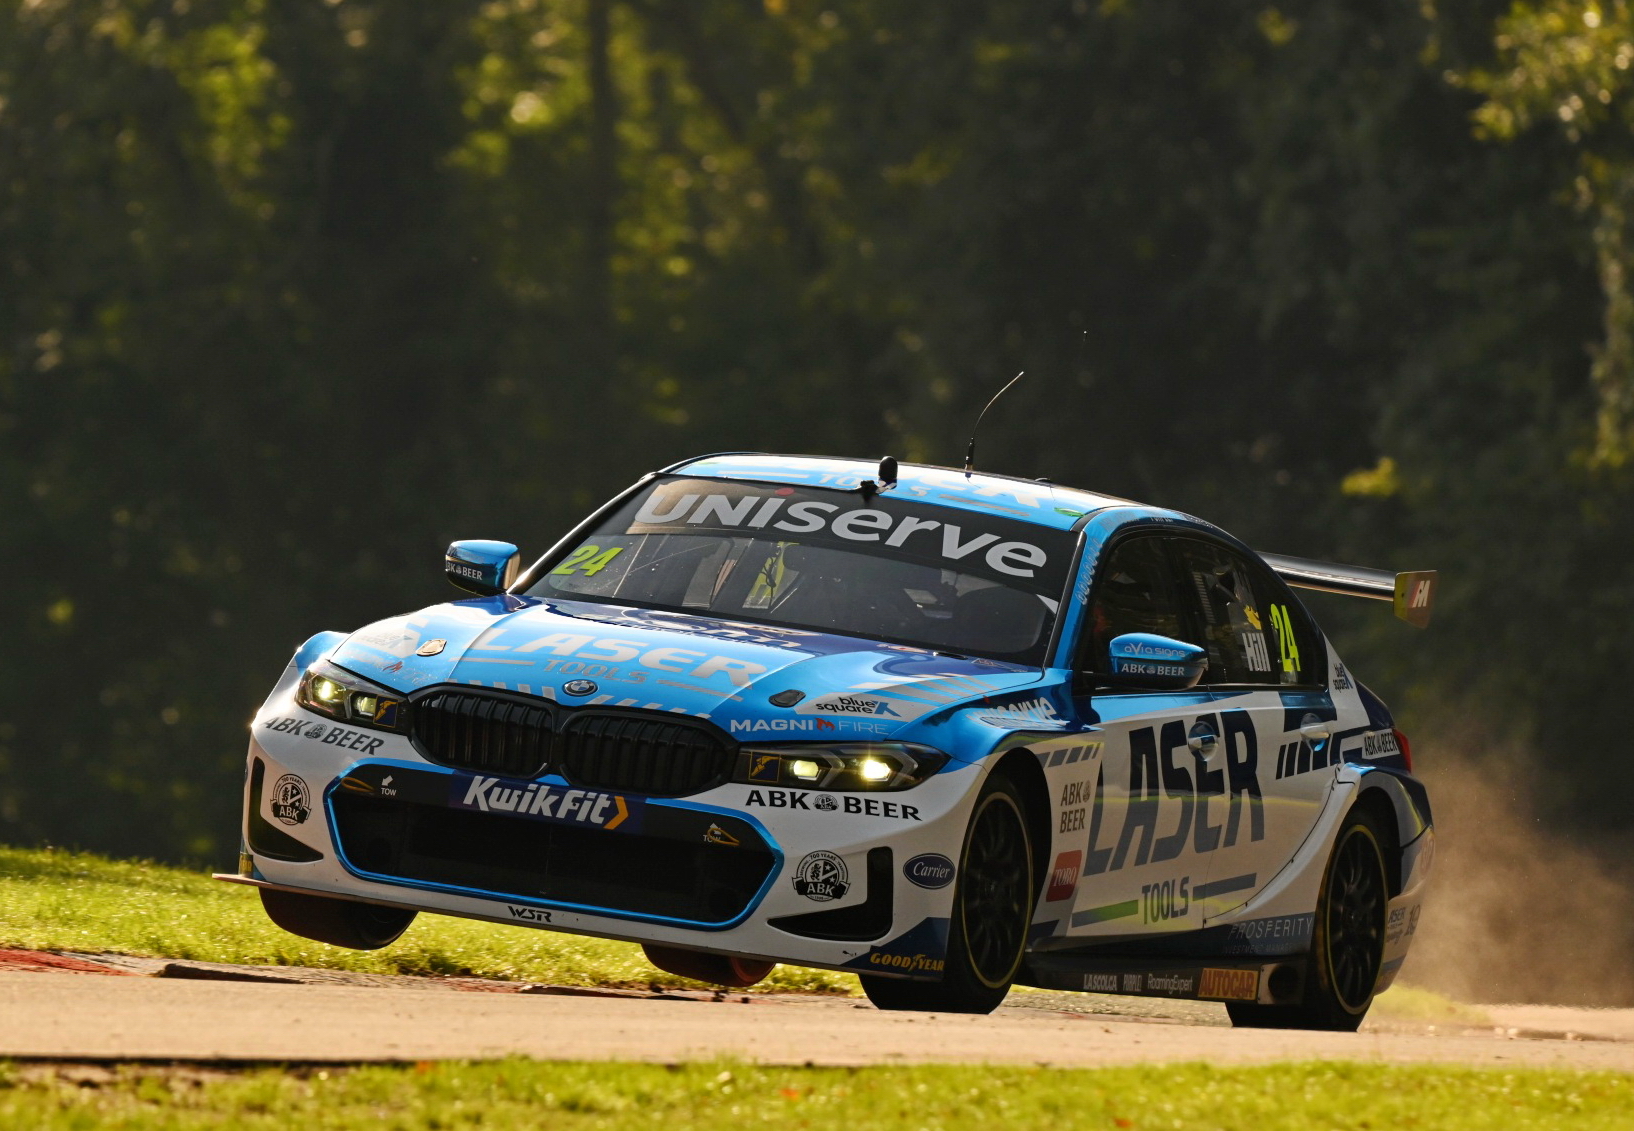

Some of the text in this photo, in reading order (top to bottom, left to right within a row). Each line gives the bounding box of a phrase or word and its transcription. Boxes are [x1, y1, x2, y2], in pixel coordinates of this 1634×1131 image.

[552, 545, 624, 577] 24
[462, 566, 483, 581] BEER
[1270, 603, 1301, 672] 24
[467, 627, 768, 688] LASER
[1154, 646, 1186, 658] signs
[1242, 632, 1272, 672] Hill
[543, 659, 652, 684] TOOLS
[1121, 663, 1185, 676] ABK BEER
[815, 702, 873, 714] square
[838, 696, 876, 708] blue
[261, 717, 313, 736] ABK
[321, 726, 385, 756] BEER
[1380, 732, 1398, 753] BEER
[381, 787, 397, 797] TOW
[1060, 781, 1084, 807] ABK
[1083, 708, 1265, 877] LASER
[280, 805, 300, 821] ABK
[745, 790, 811, 811] ABK
[843, 795, 923, 821] BEER
[1060, 808, 1086, 834] BEER
[913, 861, 951, 879] Carrier
[1053, 866, 1078, 887] TORO
[807, 883, 835, 898] ABK
[1142, 876, 1189, 925] TOOLS
[507, 905, 552, 923] WSR
[1199, 969, 1255, 998] AUTOCAR
